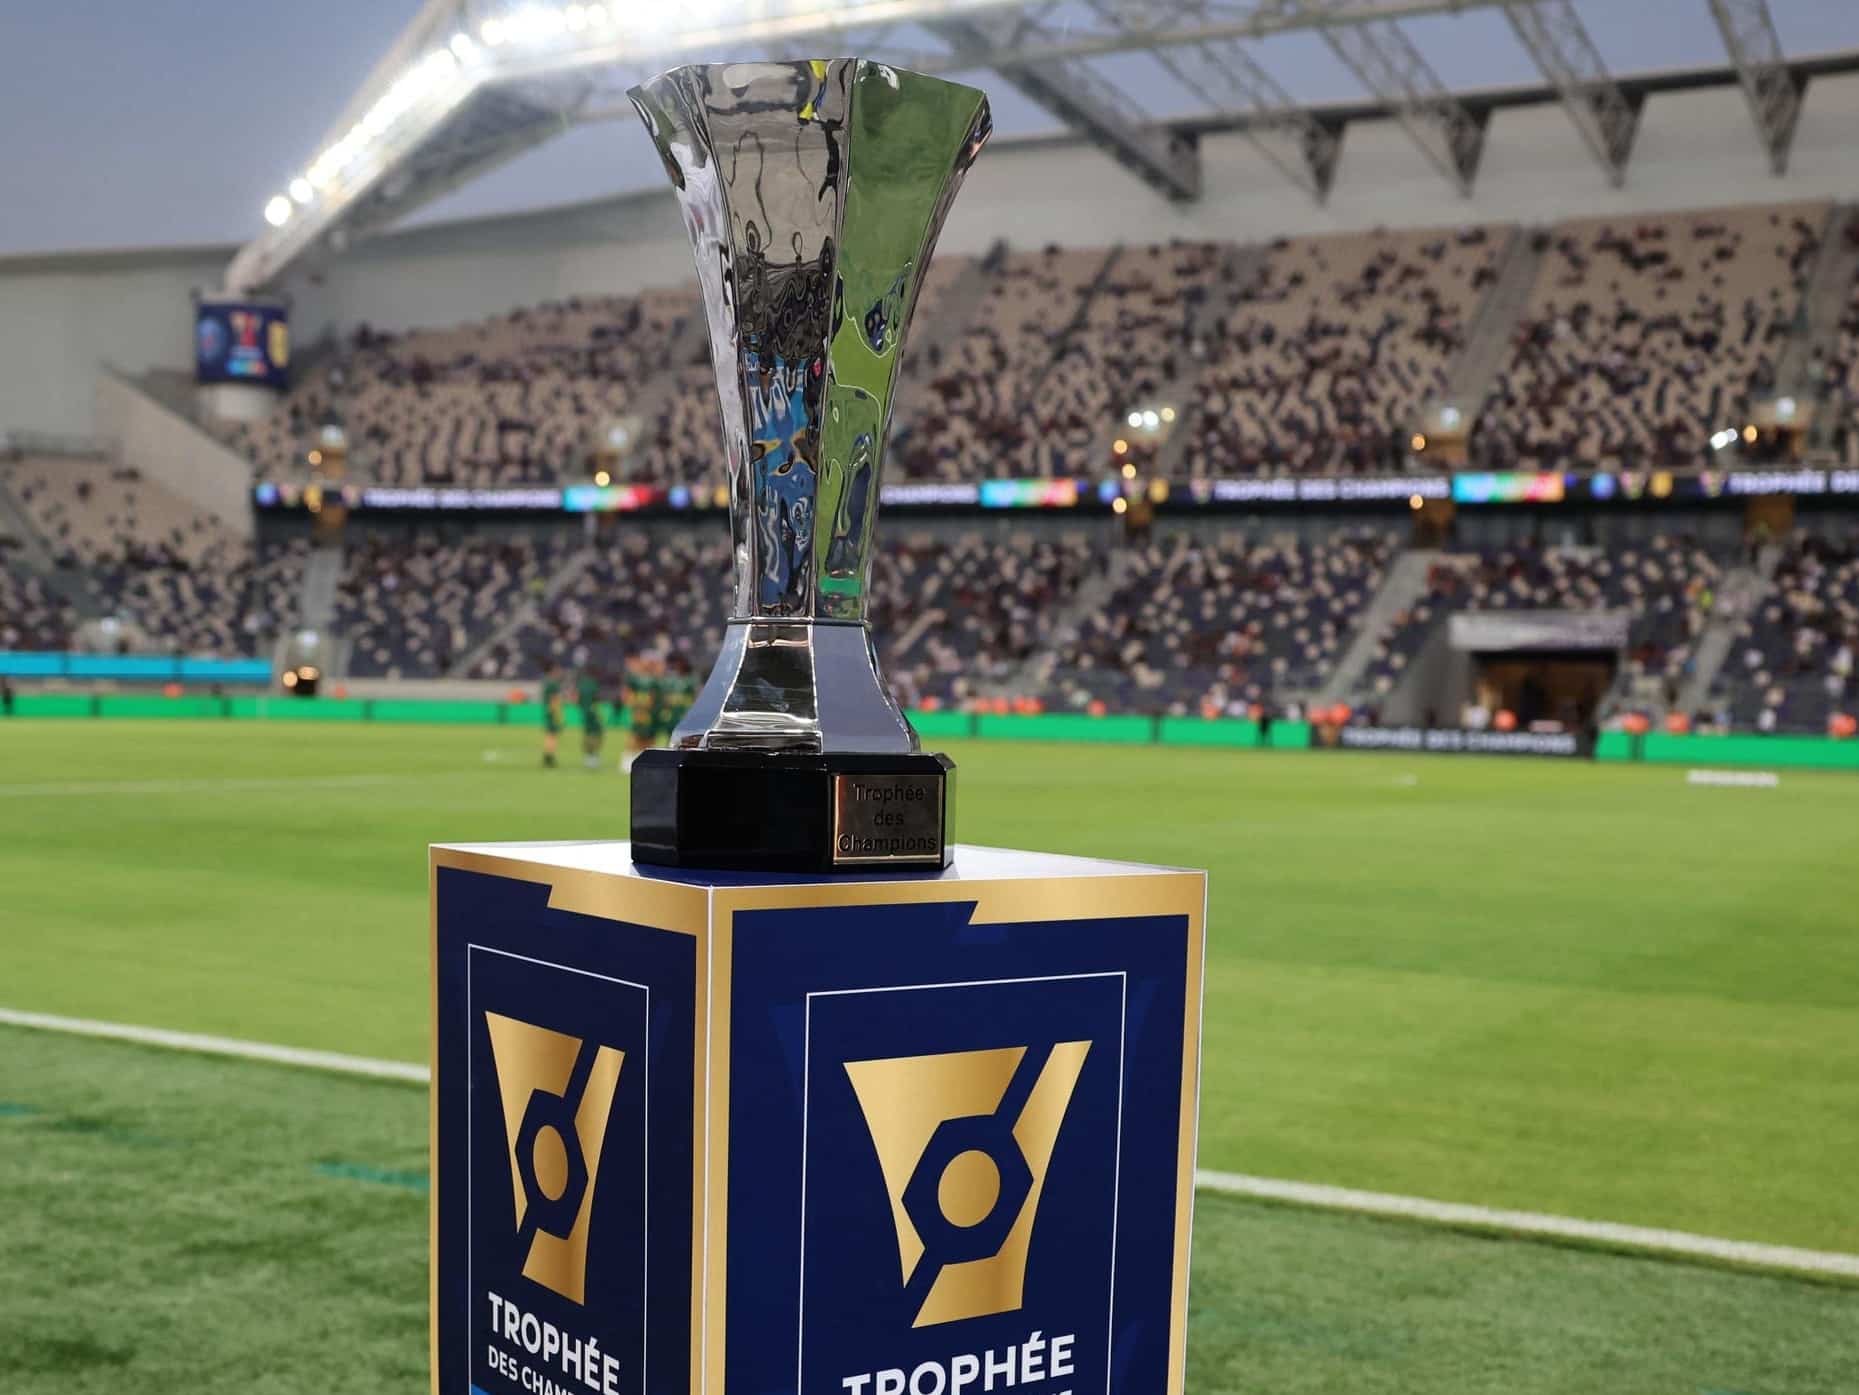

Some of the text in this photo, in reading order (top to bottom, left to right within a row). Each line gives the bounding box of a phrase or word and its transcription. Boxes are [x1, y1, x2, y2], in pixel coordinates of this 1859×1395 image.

[853, 784, 925, 804] Trophée
[873, 809, 904, 826] des
[837, 832, 937, 854] Champions
[488, 1291, 620, 1395] TROPHÉE
[488, 1344, 574, 1395] DES CHAM
[842, 1331, 1075, 1395] TROPHÉE
